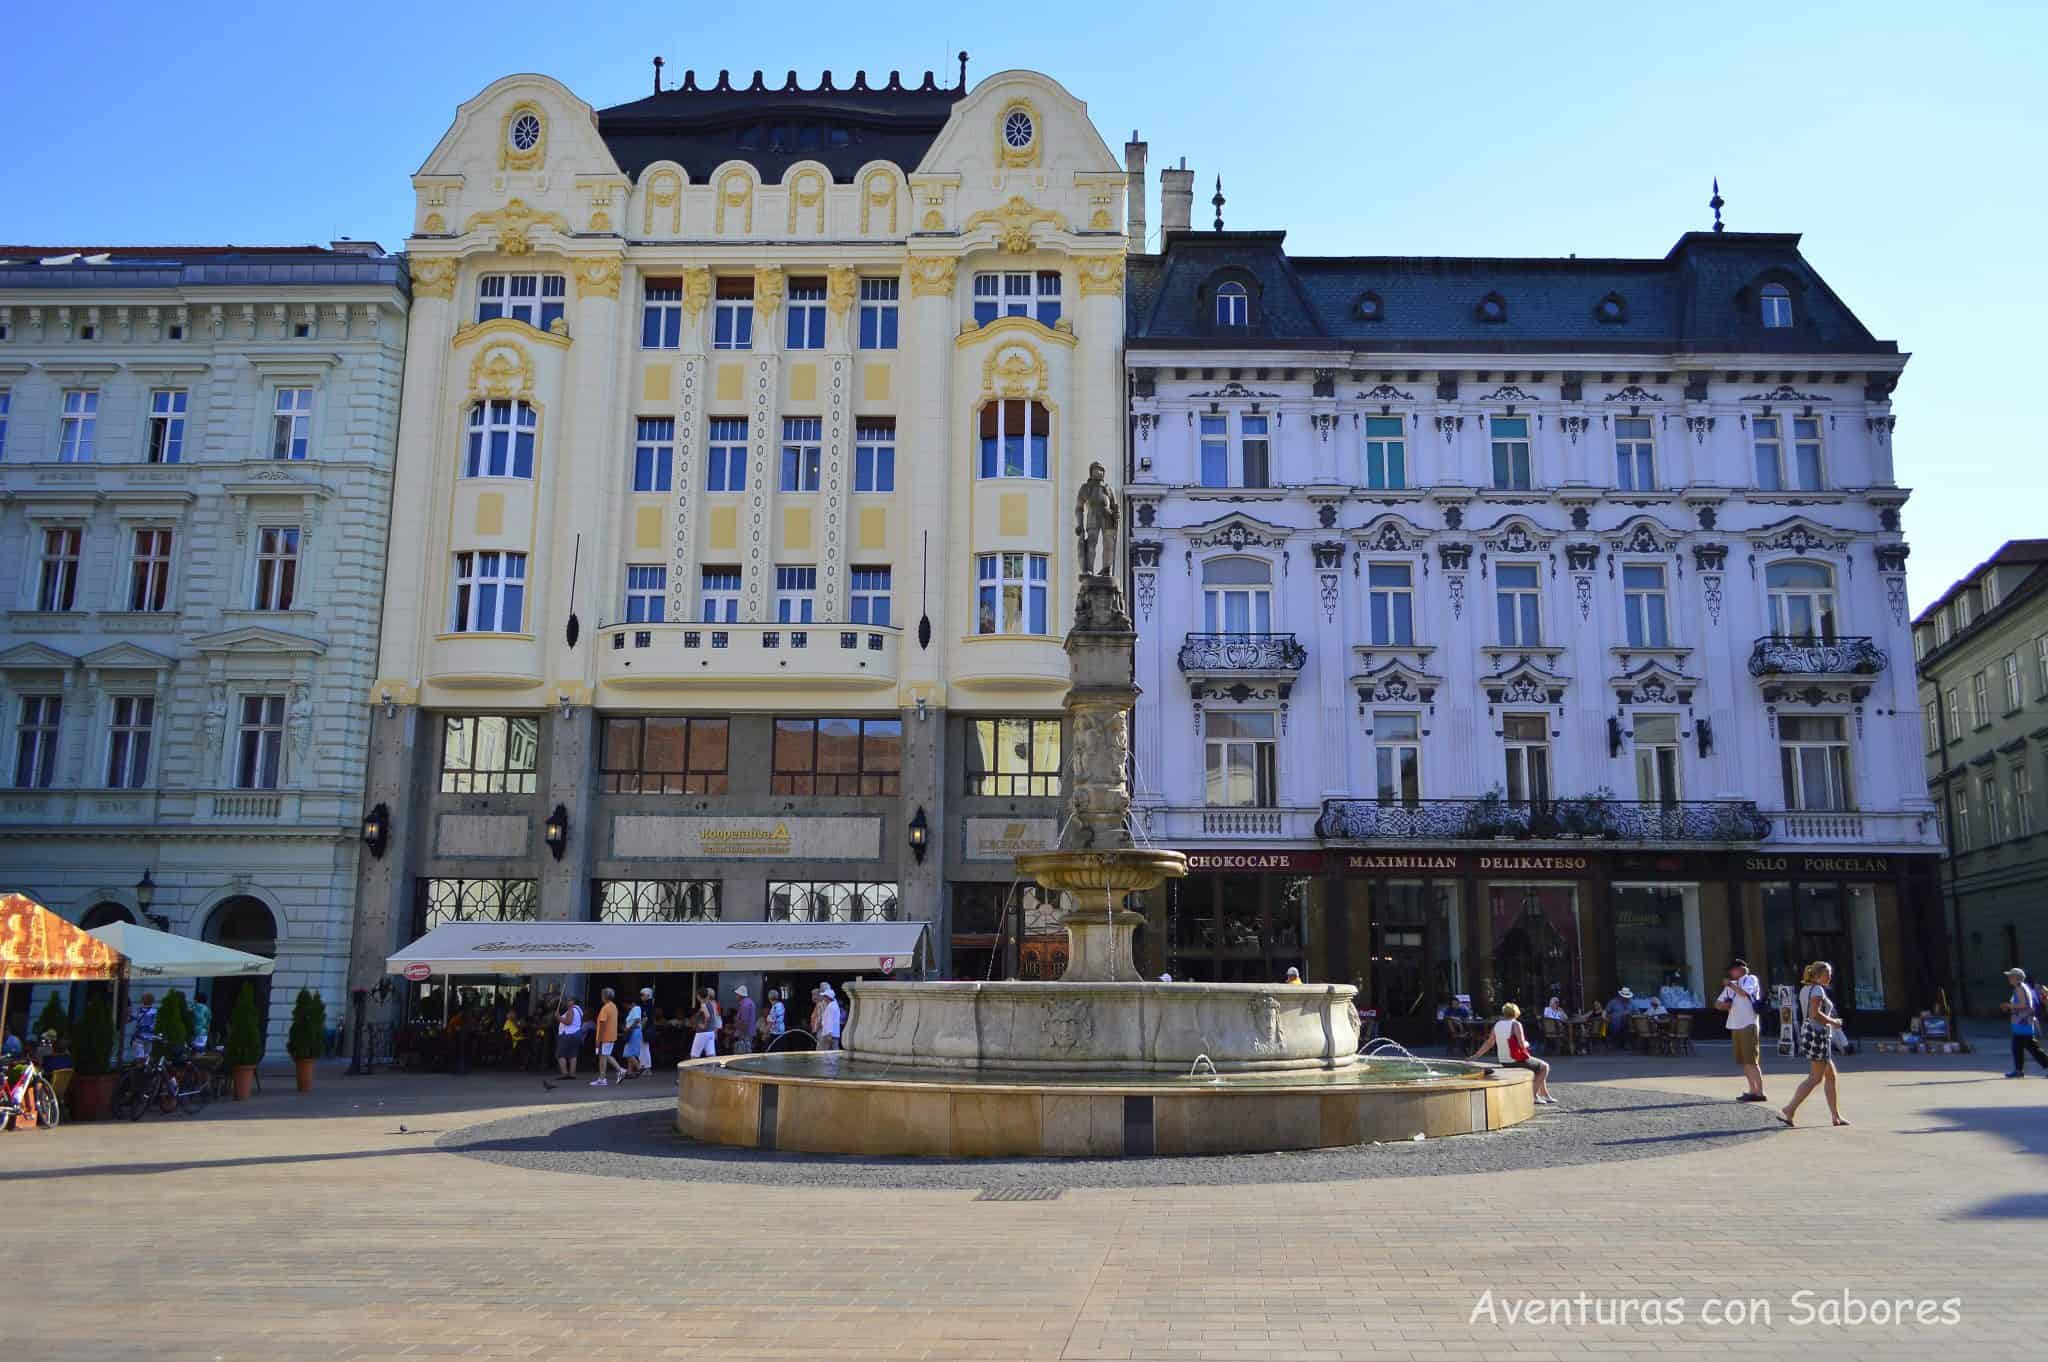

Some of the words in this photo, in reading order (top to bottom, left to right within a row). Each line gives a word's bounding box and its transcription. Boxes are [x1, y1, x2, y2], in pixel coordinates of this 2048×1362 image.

[1187, 856, 1290, 867] CHOKOCAFE
[1350, 856, 1457, 868] MAXIMILIAN
[1480, 857, 1586, 868] DELIKATESO
[1746, 857, 1788, 870] SKLO
